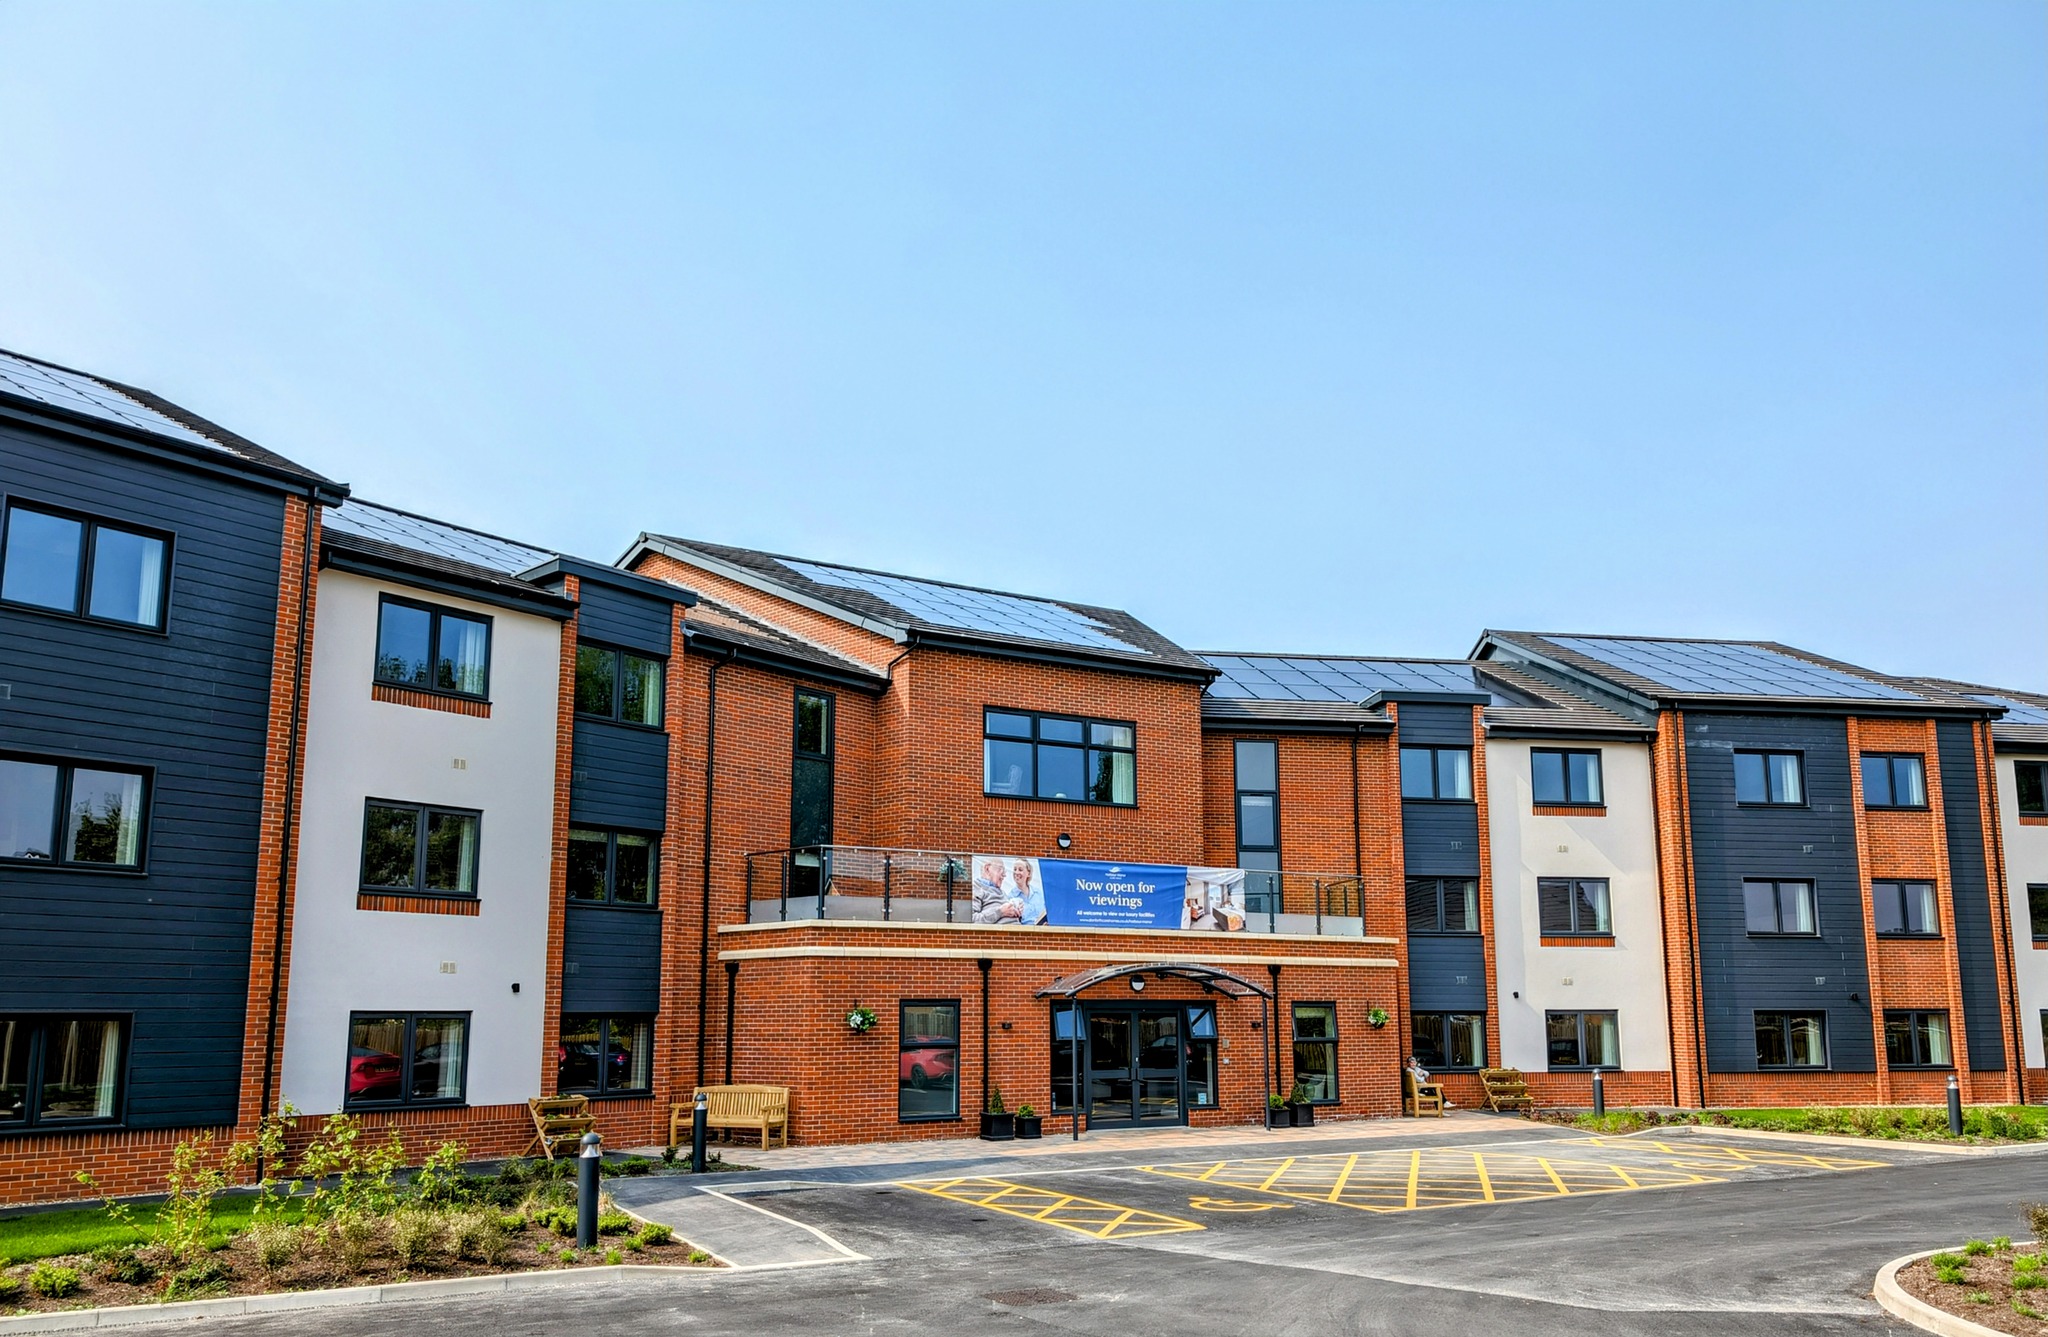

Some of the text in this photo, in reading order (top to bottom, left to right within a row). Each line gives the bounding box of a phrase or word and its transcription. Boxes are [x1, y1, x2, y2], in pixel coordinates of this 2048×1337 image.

[1076, 879, 1156, 895] Now open for
[1089, 894, 1143, 909] viewings
